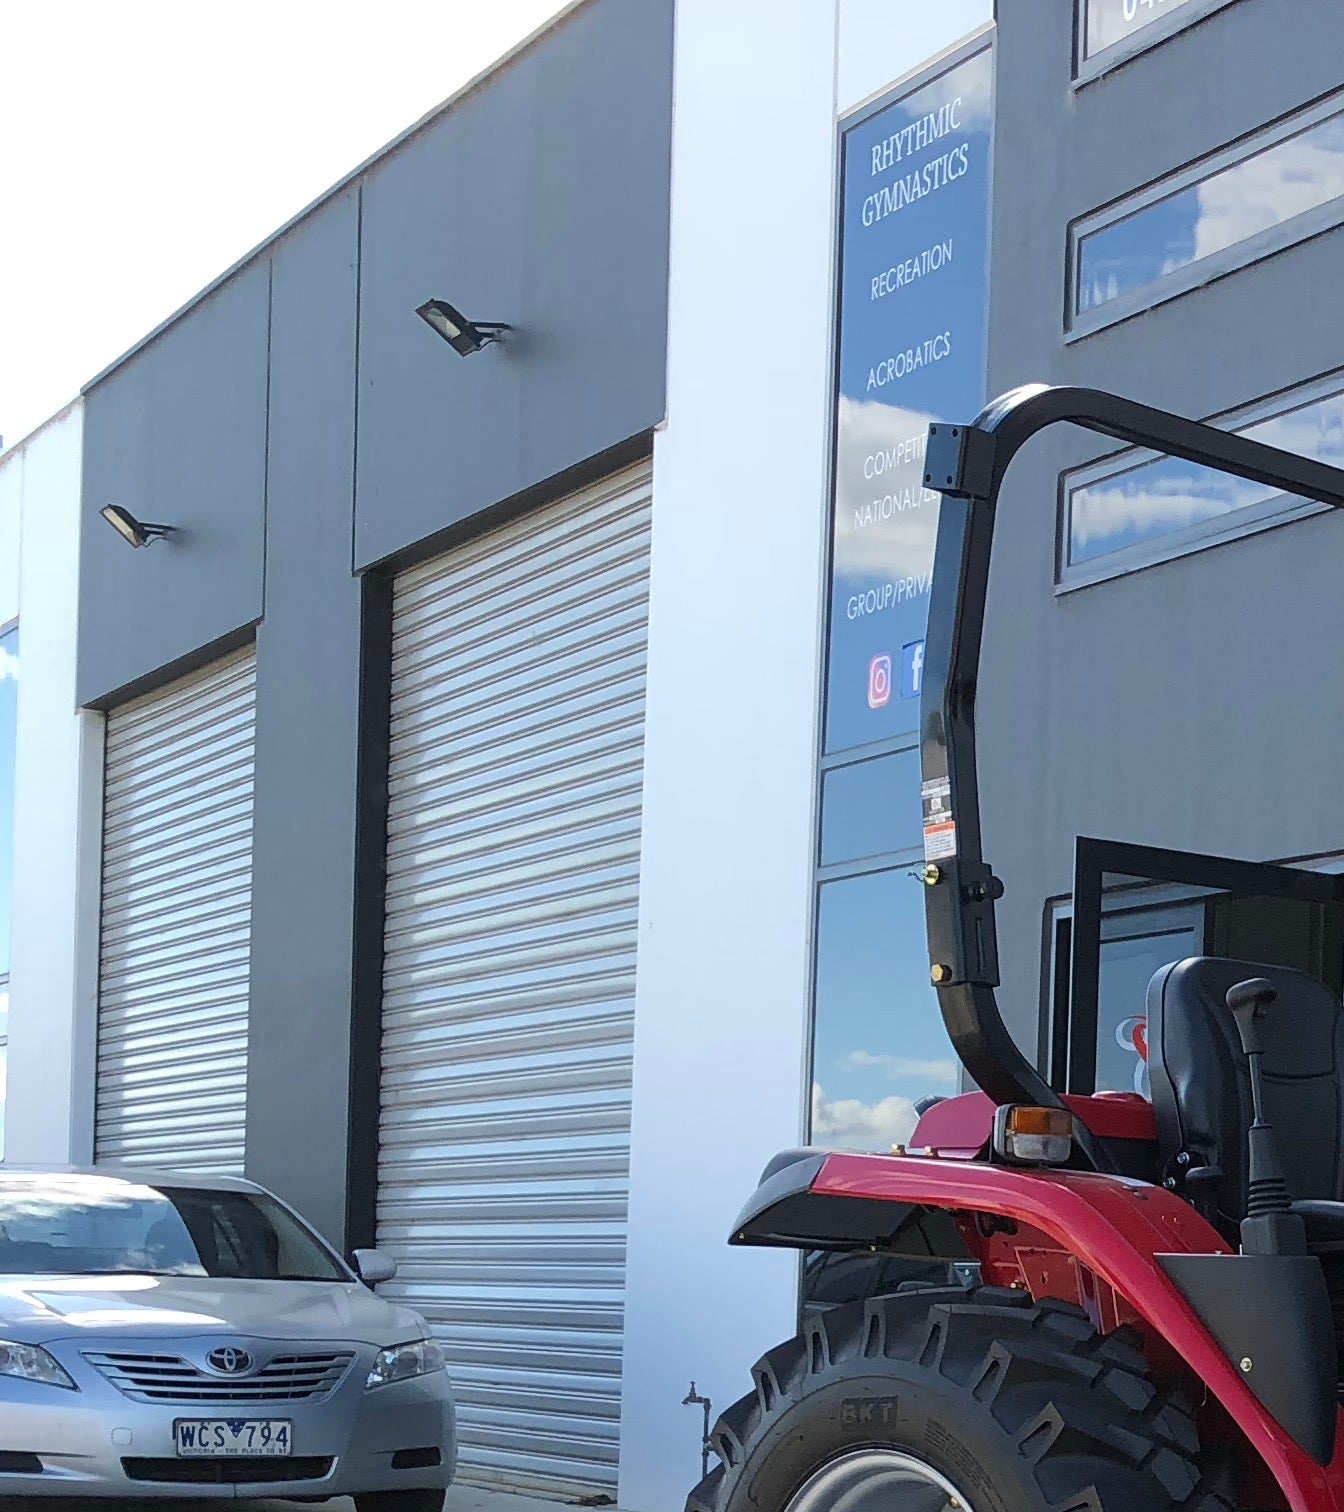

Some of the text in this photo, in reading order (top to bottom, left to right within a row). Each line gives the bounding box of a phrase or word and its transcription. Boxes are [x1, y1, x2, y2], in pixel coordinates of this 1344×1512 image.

[871, 97, 962, 177] RHYTHMIC
[861, 143, 969, 227] GYMNASTICS
[870, 238, 953, 301] RECREATION
[866, 331, 951, 392] ACROBATICS
[180, 1425, 288, 1448] WCS 794
